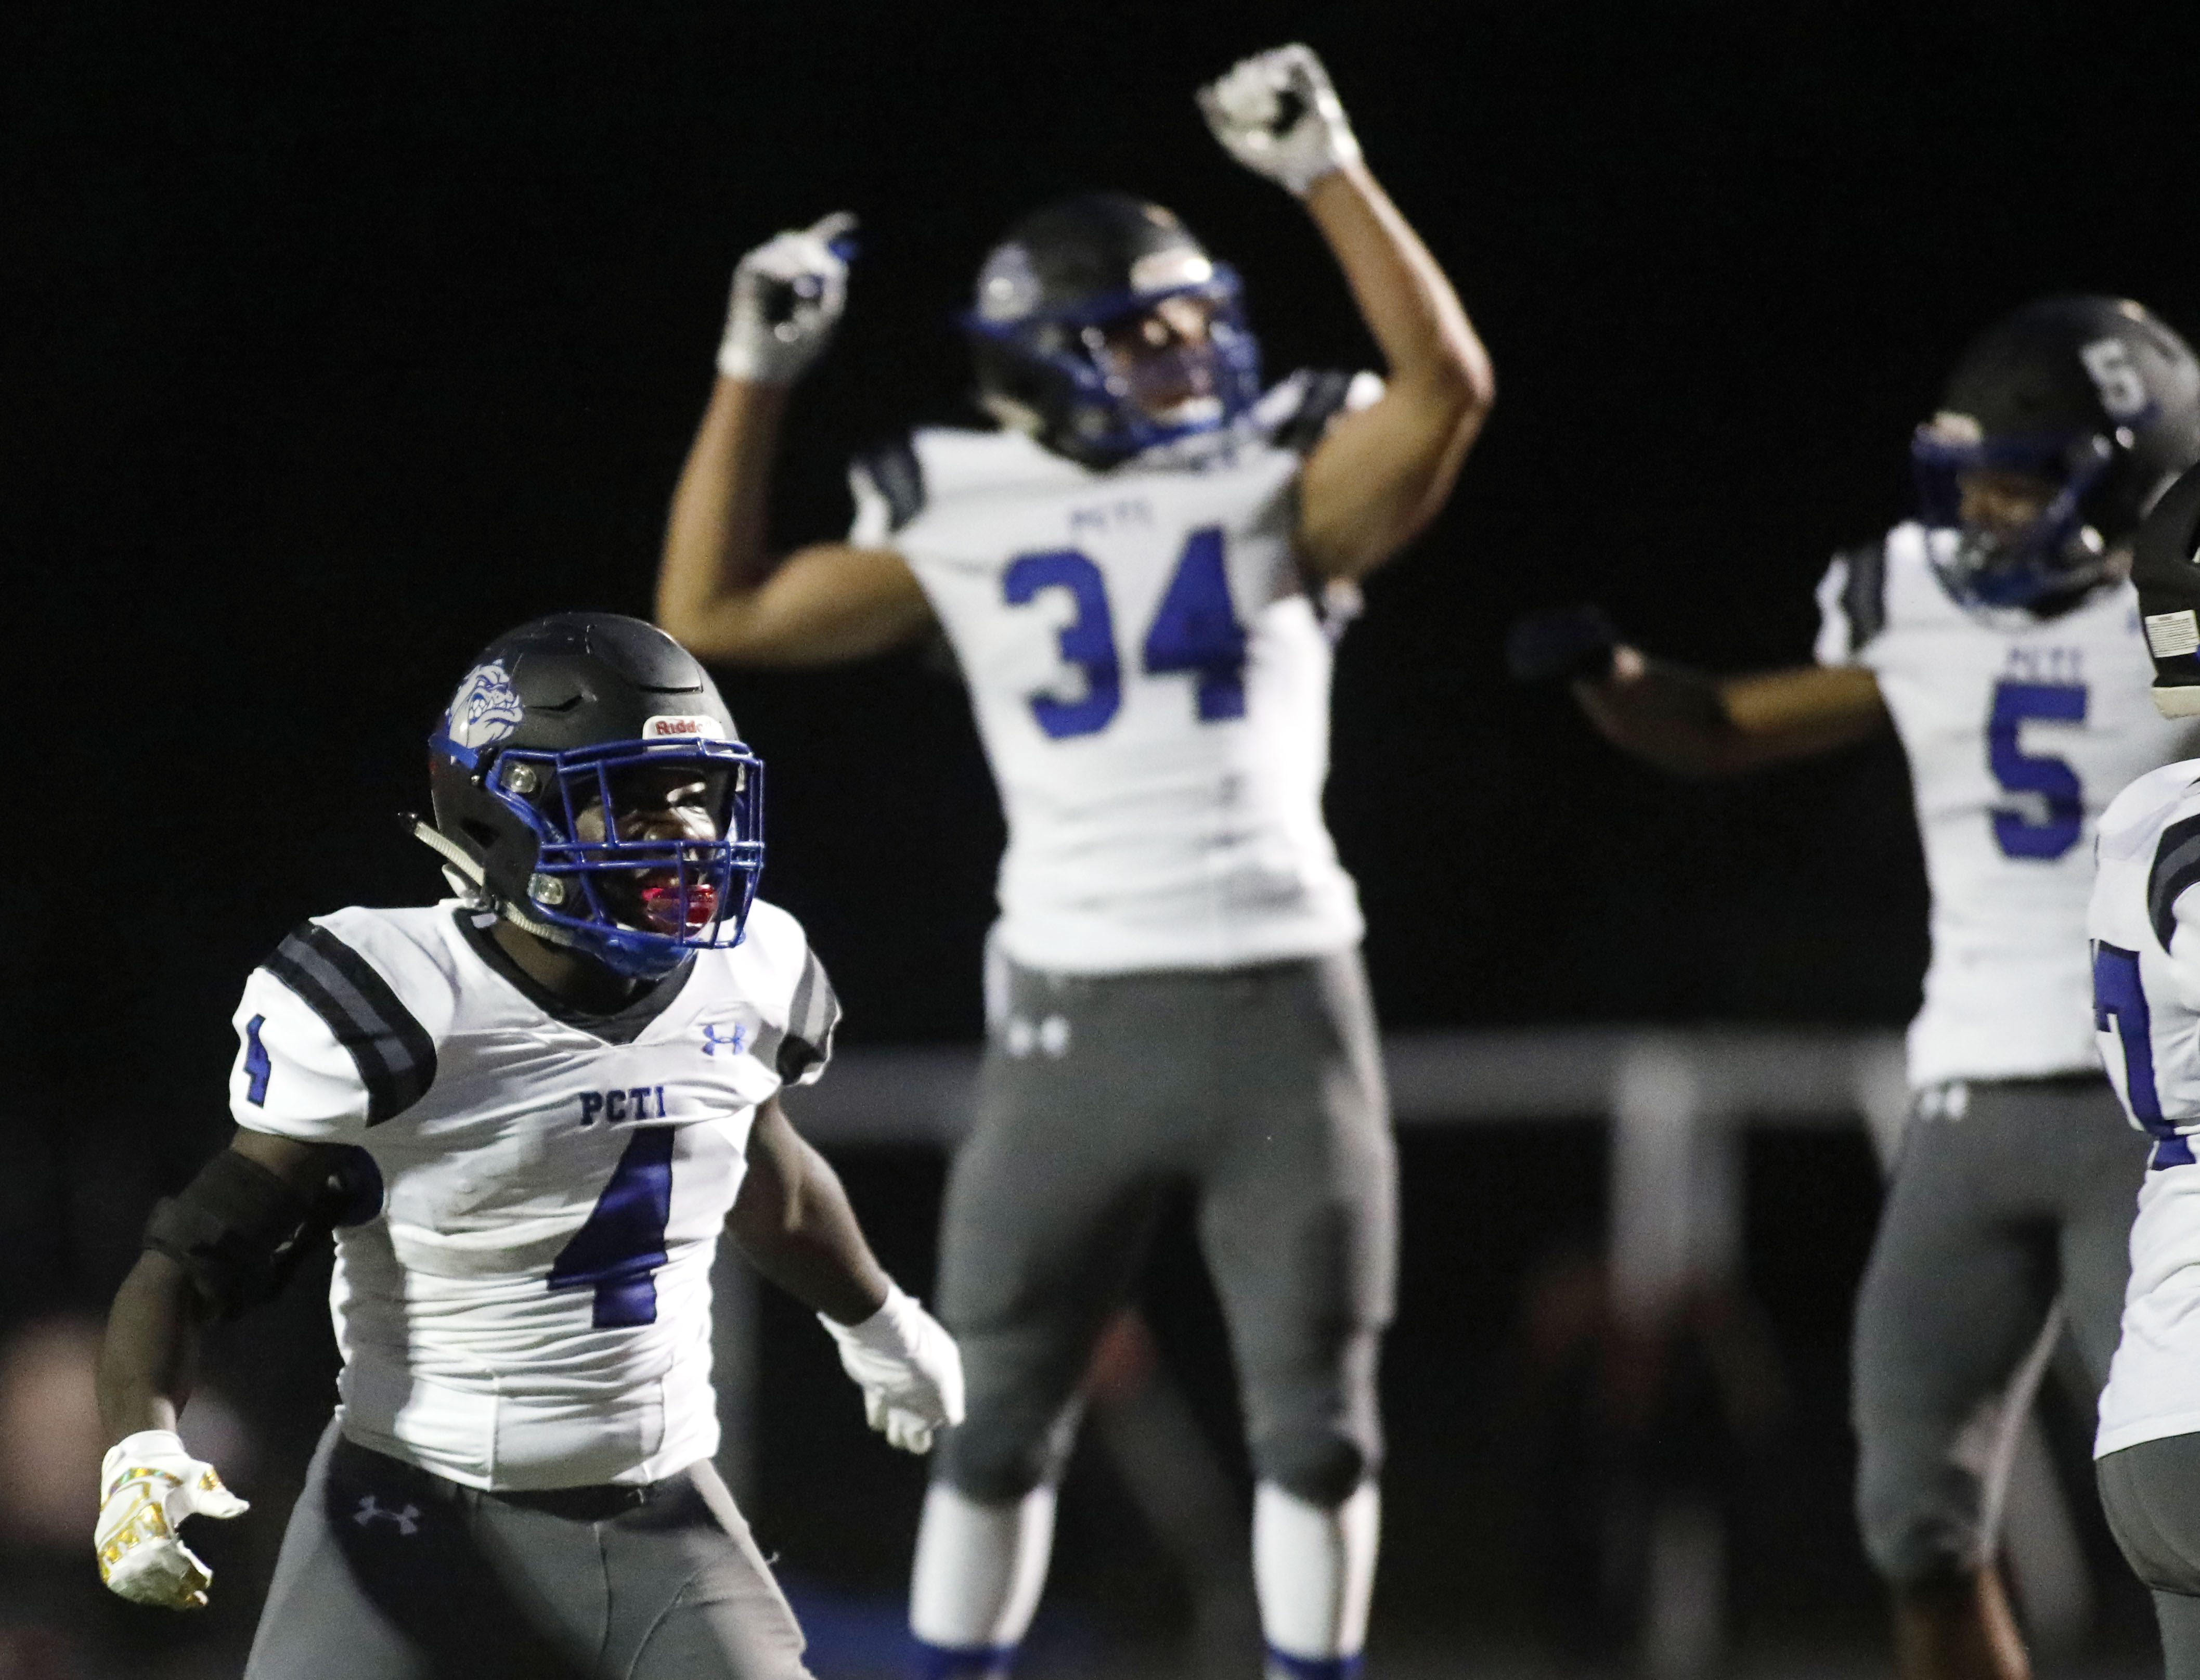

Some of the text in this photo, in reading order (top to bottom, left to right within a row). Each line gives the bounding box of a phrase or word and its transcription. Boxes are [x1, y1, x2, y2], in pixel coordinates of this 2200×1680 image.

[2080, 340, 2146, 414] 5
[1000, 523, 1248, 740] 34
[655, 719, 711, 735] Ridde
[1989, 680, 2088, 860] 5
[579, 1085, 666, 1125] PCTI
[546, 1125, 676, 1328] 4
